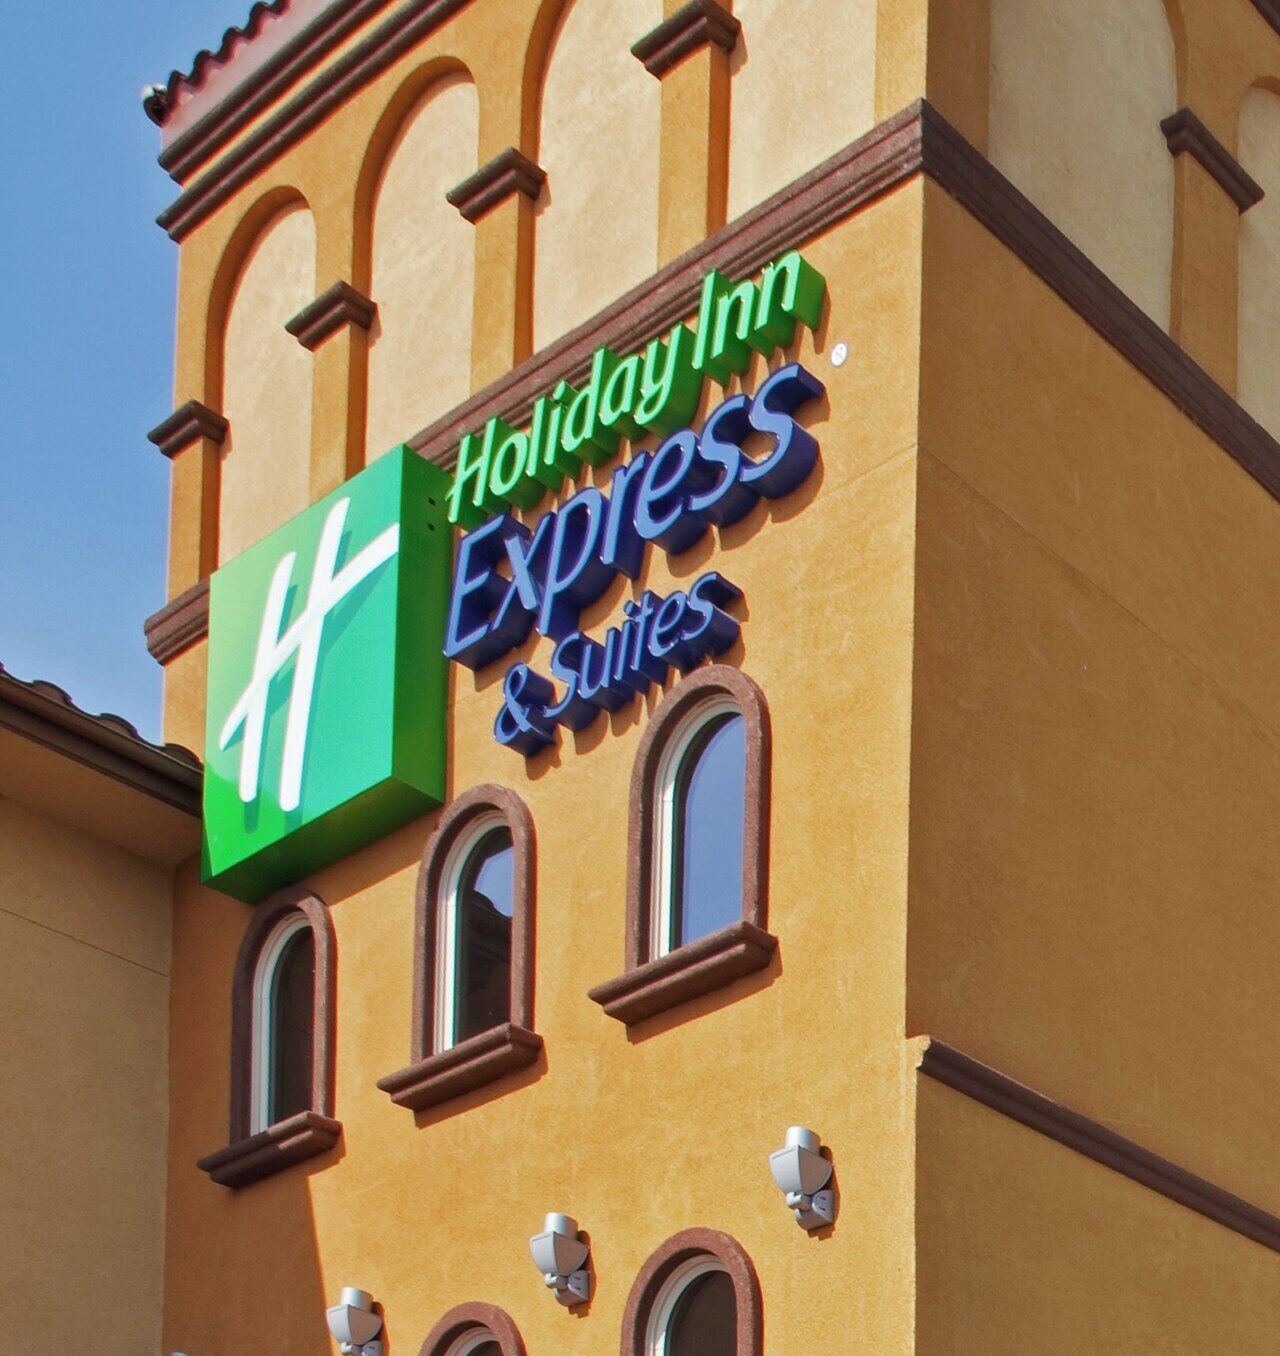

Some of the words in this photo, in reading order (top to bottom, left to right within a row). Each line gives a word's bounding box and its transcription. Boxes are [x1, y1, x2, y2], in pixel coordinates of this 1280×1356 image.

[443, 362, 815, 666] Express
[446, 321, 690, 526] Holiday
[692, 249, 815, 374] Inn
[493, 661, 548, 749] &
[543, 571, 732, 722] Suites
